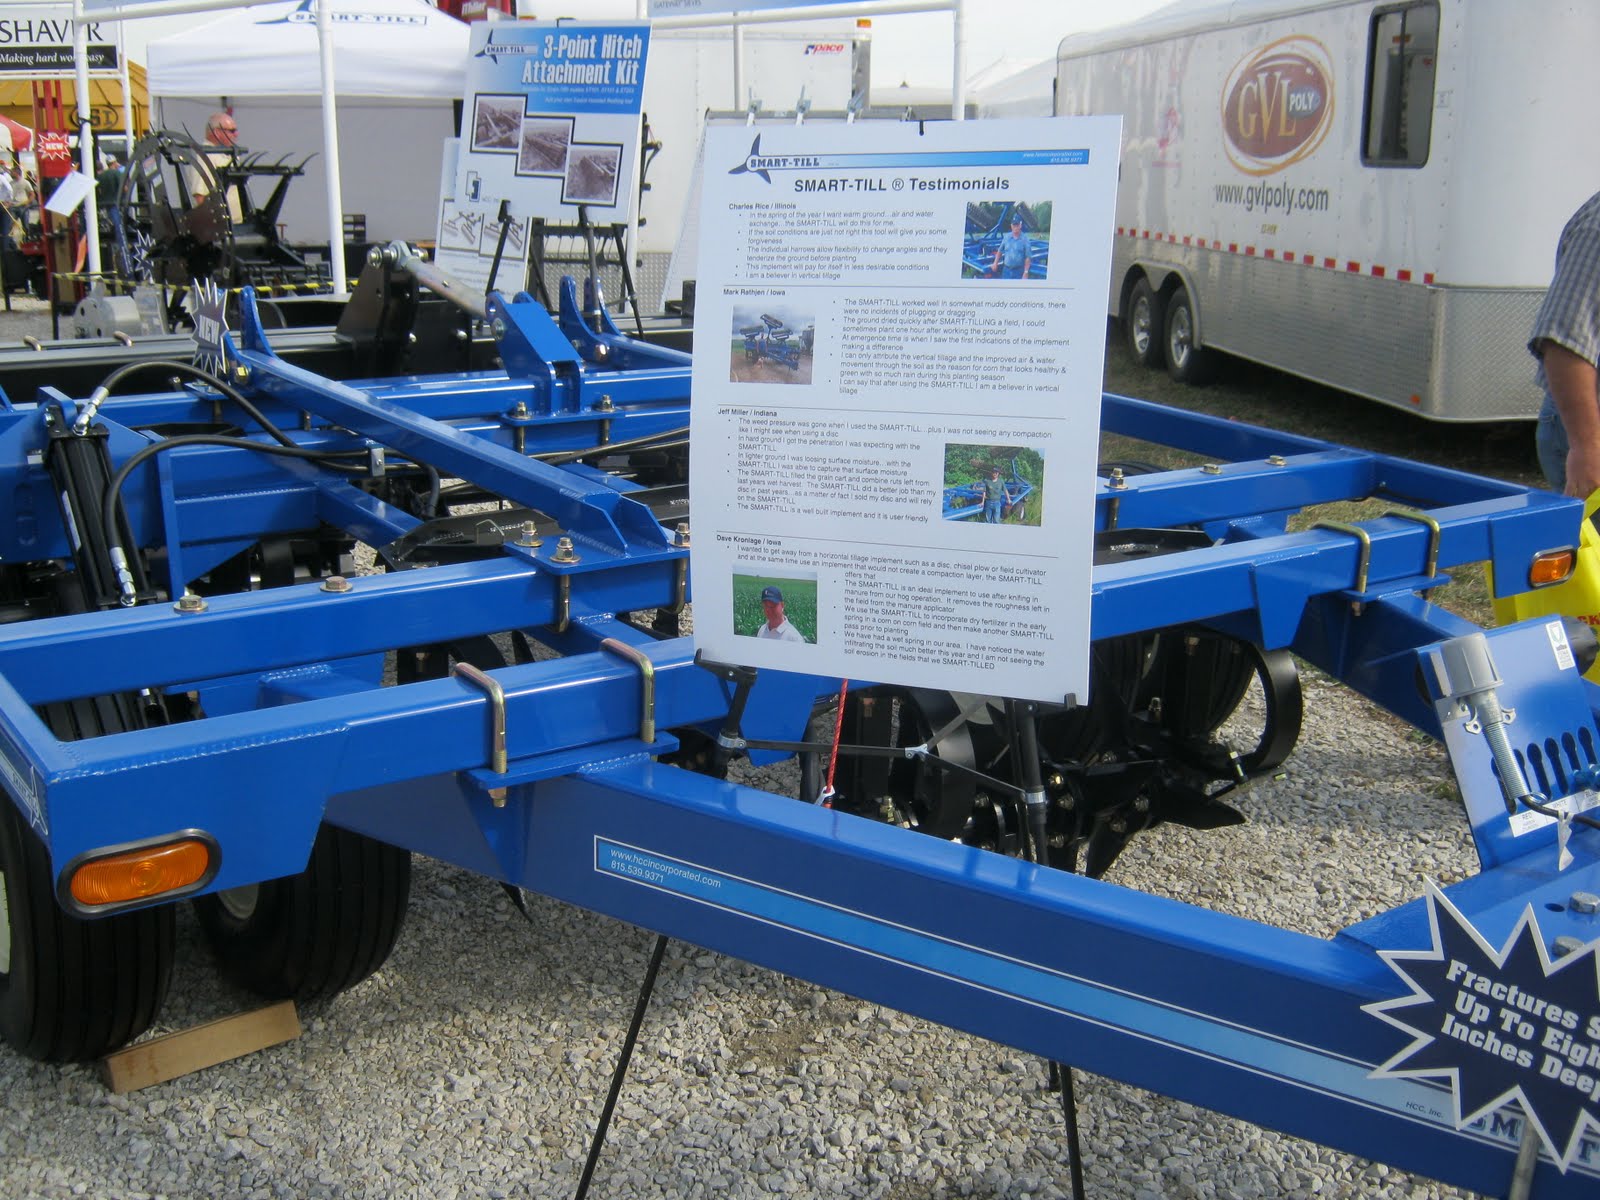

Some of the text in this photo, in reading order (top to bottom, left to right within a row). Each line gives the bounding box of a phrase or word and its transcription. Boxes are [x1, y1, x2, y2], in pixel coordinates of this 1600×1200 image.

[0, 20, 104, 43] SHAVR
[544, 34, 642, 58] 3-Point Hitch
[0, 52, 34, 66] Making
[36, 52, 58, 63] hard
[522, 60, 640, 84] Attachment Kit
[1238, 71, 1296, 144] GVL
[1288, 92, 1314, 112] POLY
[750, 158, 820, 168] SMART-TILL
[794, 178, 887, 192] SMART-TILL
[910, 177, 1010, 190] Testimonials
[1215, 180, 1329, 216] www.gvlpoly.com
[985, 301, 1008, 309] muddy
[199, 314, 220, 345] NEW
[738, 443, 777, 451] SMART-TILL
[750, 504, 789, 512] SMART-TILL
[830, 509, 862, 518] implement
[905, 514, 928, 524] friendly
[734, 536, 762, 545] Kronlage
[819, 552, 849, 560] horizontal
[850, 554, 869, 563] tillage
[870, 556, 903, 565] implement
[937, 561, 952, 570] disc,
[1016, 568, 1046, 576] cultivator
[858, 581, 899, 590] SMART-TILL
[934, 587, 968, 597] implement
[1008, 594, 1031, 604] knifing
[844, 614, 863, 623] spring
[1010, 630, 1054, 640] SMART-TILL
[881, 609, 922, 619] SMART-TILL
[931, 613, 968, 623] incorporate
[970, 617, 980, 626] dry
[982, 618, 1008, 627] fertilizer
[1030, 624, 1047, 632] early
[884, 627, 909, 636] planting
[899, 653, 916, 661] fields
[942, 658, 995, 670] SMART-TILLED
[610, 848, 721, 888] www.hccincorporated.com
[610, 860, 664, 884] 815.539.9371
[1446, 959, 1580, 1030] Fractures
[1454, 990, 1490, 1024] Up
[1500, 1008, 1535, 1040] To
[1440, 1013, 1534, 1068] Inches
[1406, 1101, 1444, 1118] HCC, Inc.
